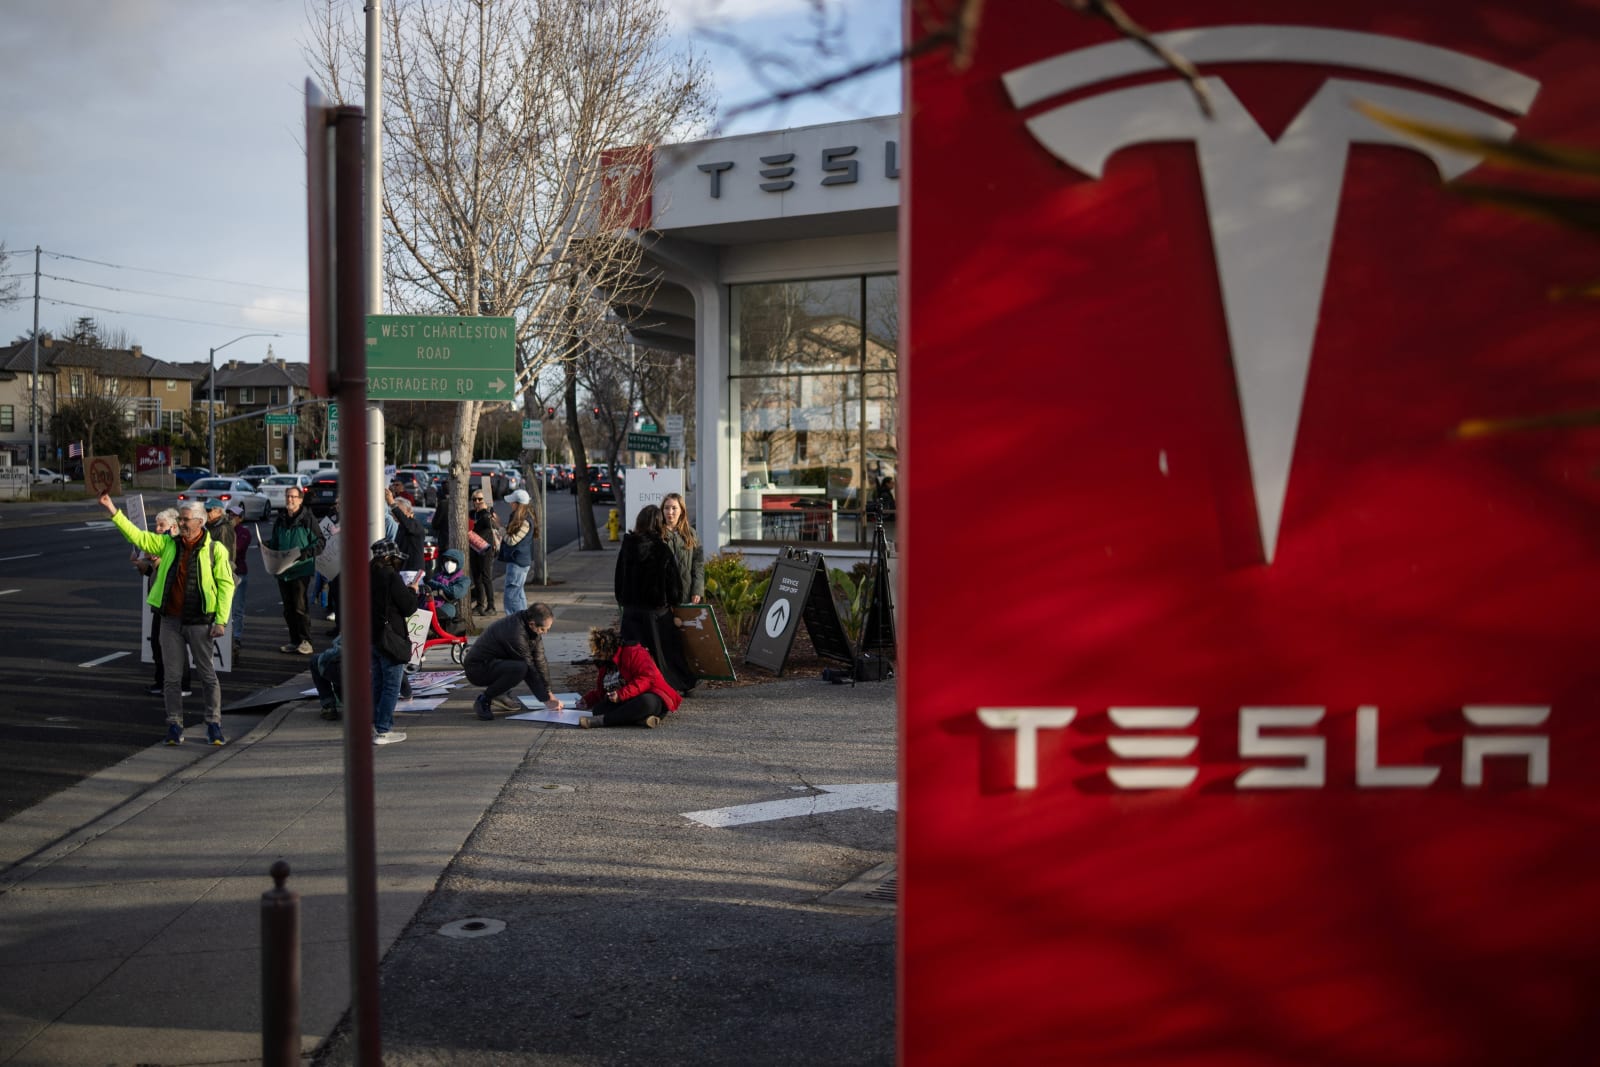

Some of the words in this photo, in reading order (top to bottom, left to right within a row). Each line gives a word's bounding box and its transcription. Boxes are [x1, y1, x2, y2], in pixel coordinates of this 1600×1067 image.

[697, 140, 900, 199] TESL
[382, 324, 416, 338] WEST
[423, 325, 508, 339] CHARLESTON
[417, 346, 450, 360] ROAD
[366, 377, 448, 391] RASTRADERO
[456, 378, 474, 391] RD
[331, 407, 338, 418] 2
[782, 577, 799, 587] SERVICE
[976, 705, 1552, 790] TESLA
